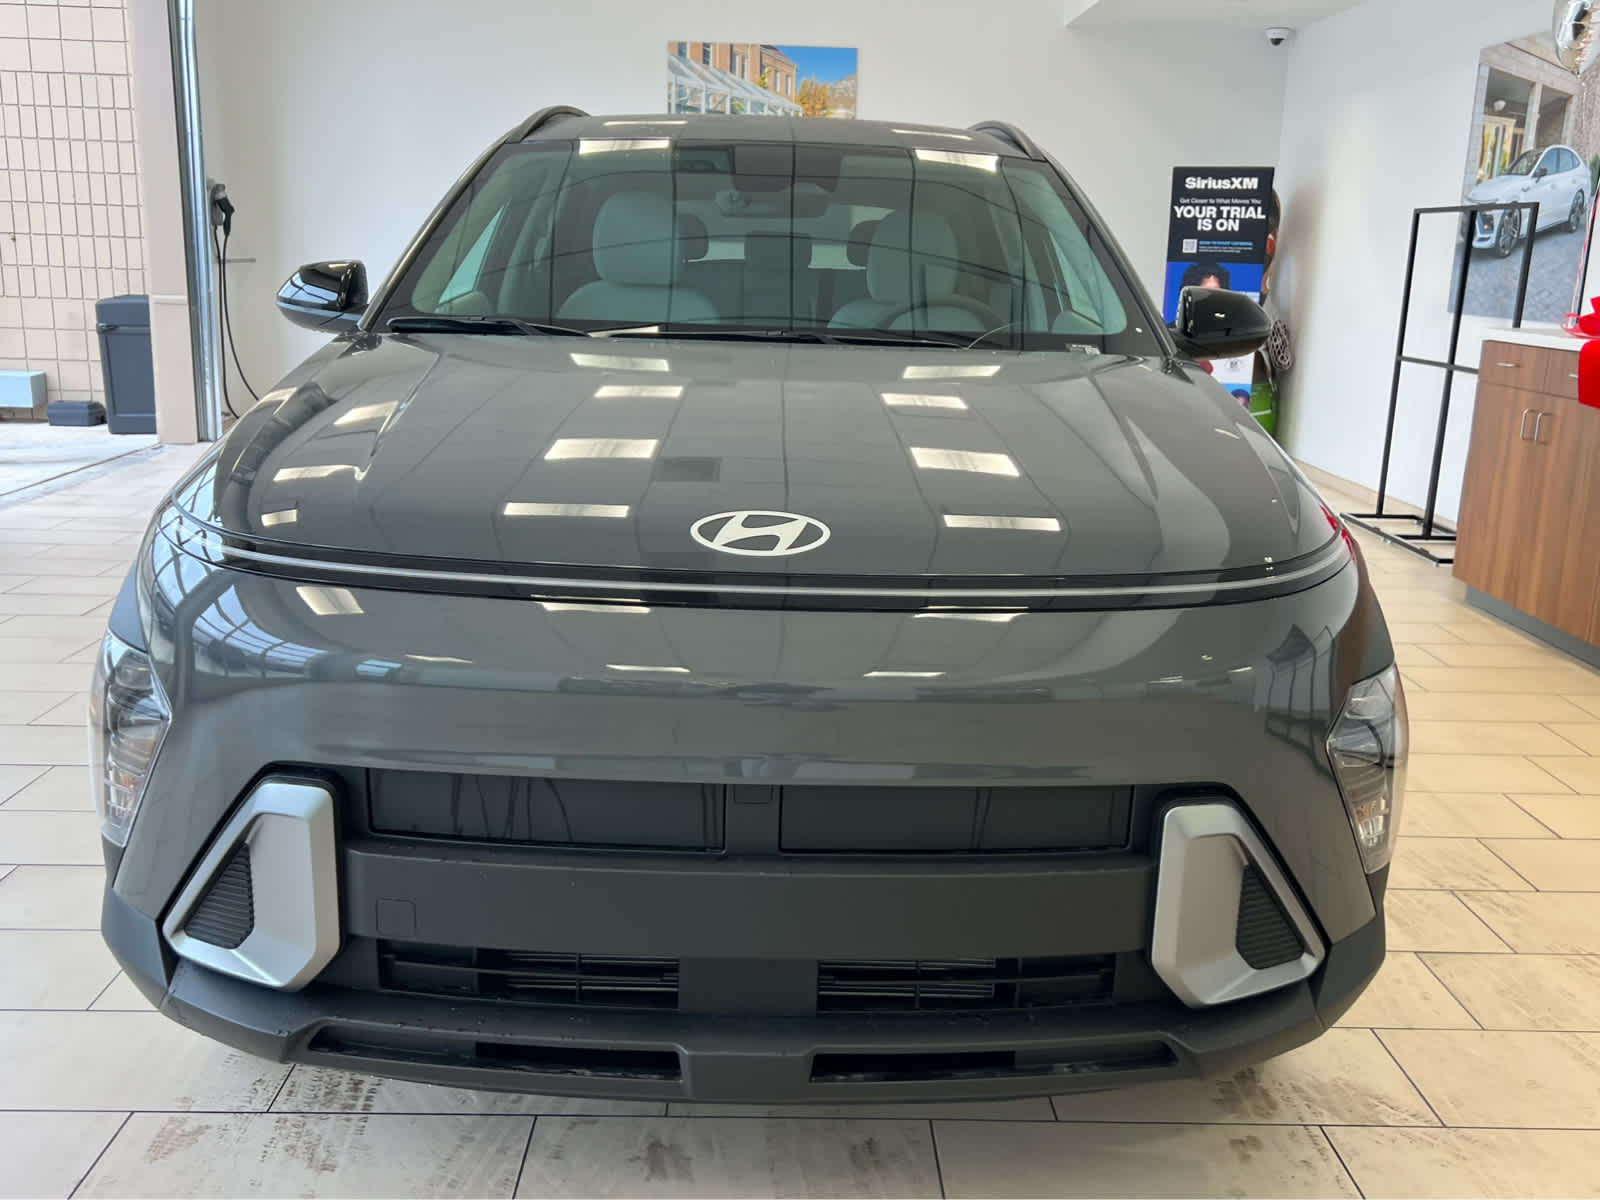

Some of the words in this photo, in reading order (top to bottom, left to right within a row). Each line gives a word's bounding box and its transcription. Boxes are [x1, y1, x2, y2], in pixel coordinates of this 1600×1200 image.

[1185, 177, 1258, 190] SiriusXM
[1173, 205, 1217, 219] YOUR
[1220, 206, 1266, 219] TRIAL
[1197, 218, 1213, 231] IS
[1215, 218, 1240, 231] ON
